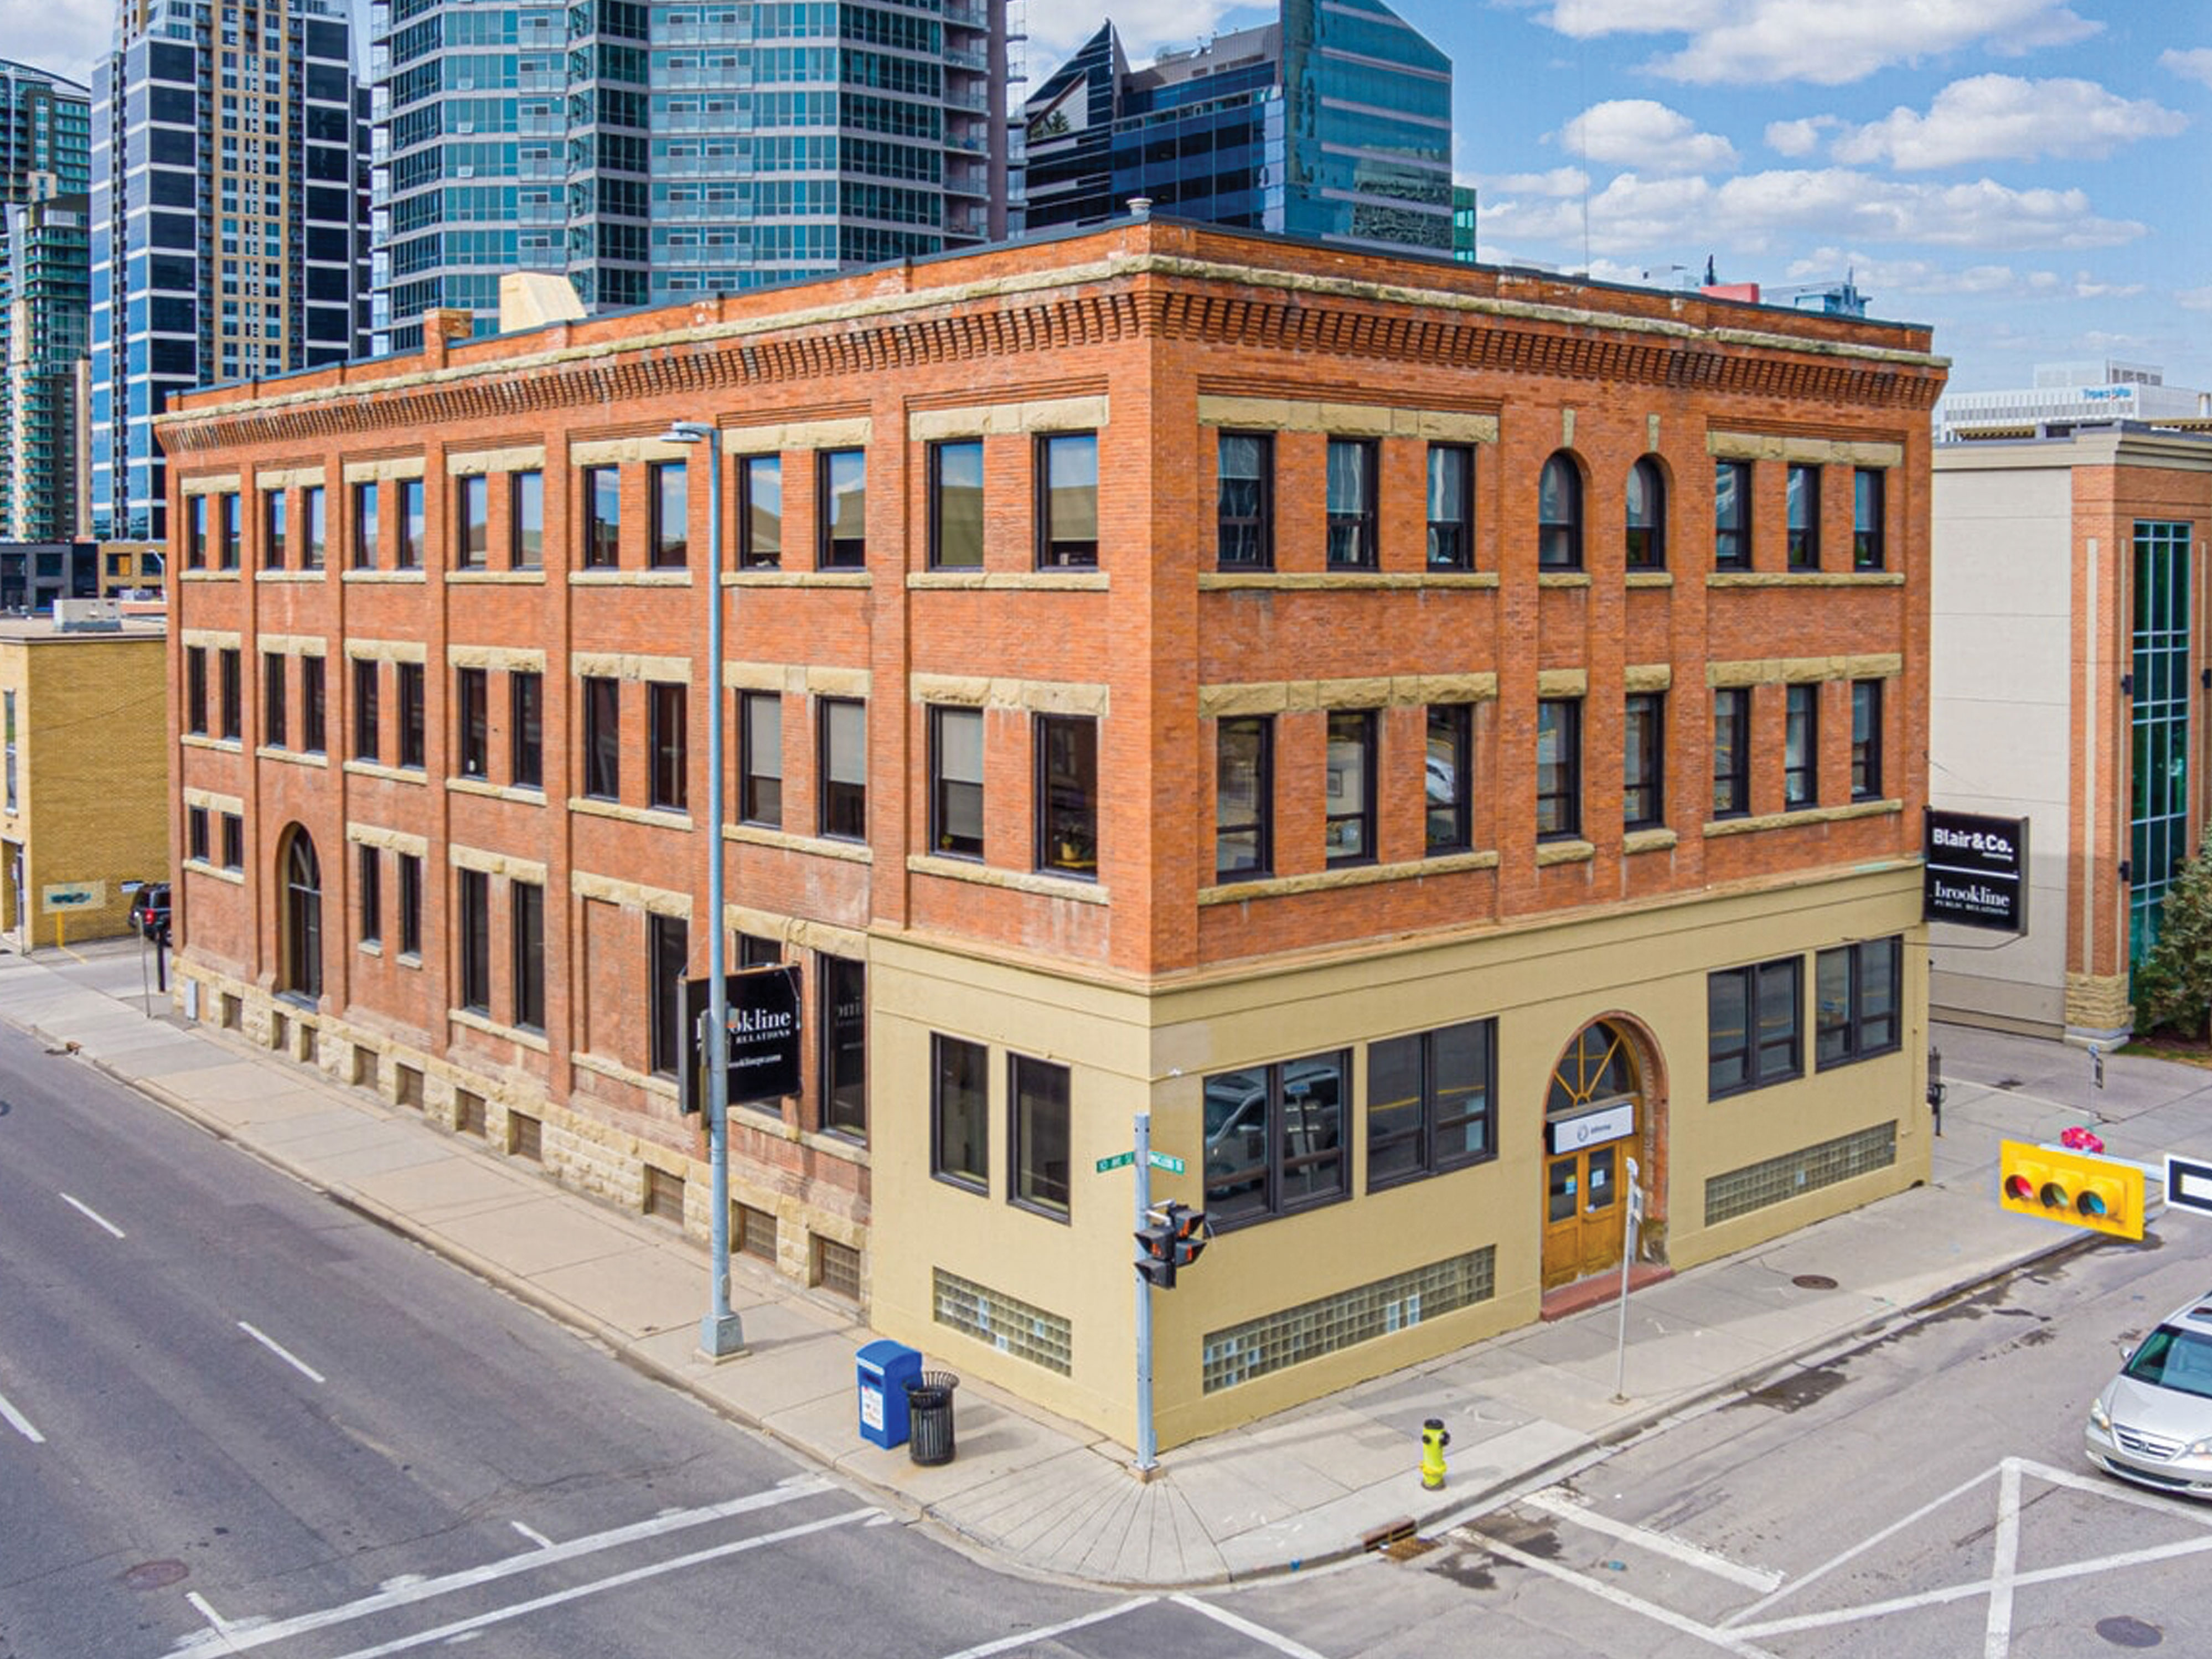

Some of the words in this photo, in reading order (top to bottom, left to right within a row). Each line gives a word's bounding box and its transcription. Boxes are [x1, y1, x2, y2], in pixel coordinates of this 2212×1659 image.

[1932, 828, 2013, 853] Blair&Co.
[1935, 880, 2009, 907] brookline
[736, 1029, 790, 1045] RELATIONS
